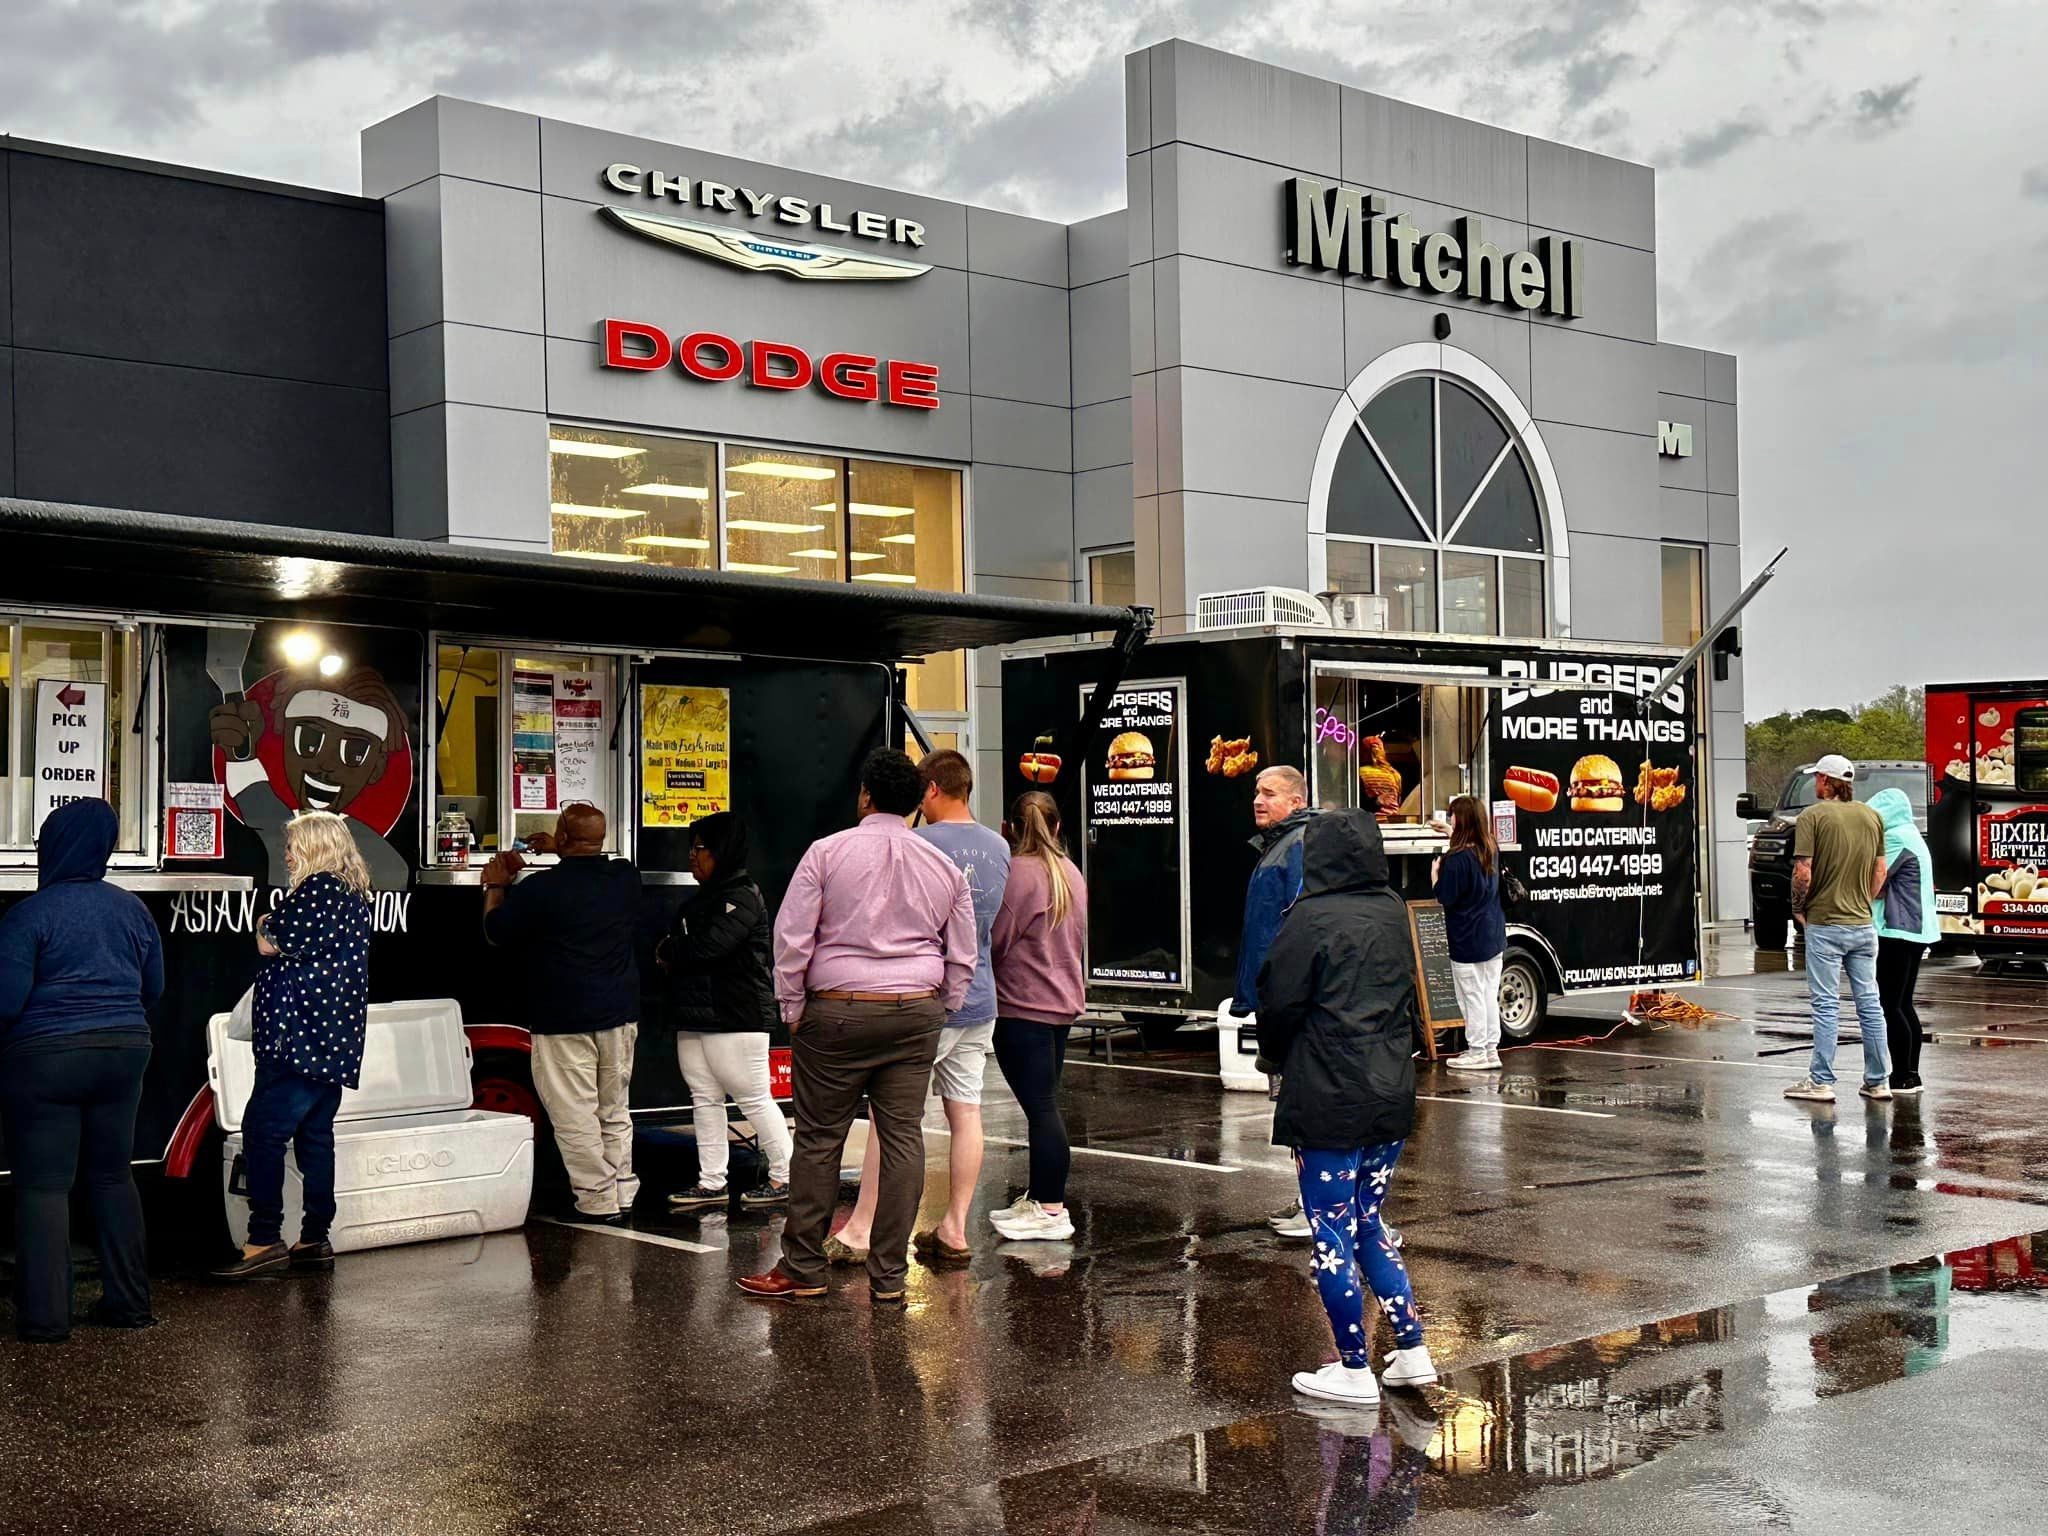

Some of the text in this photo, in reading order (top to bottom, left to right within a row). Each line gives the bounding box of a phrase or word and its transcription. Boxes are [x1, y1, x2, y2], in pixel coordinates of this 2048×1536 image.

[604, 163, 927, 248] CHRYSLER
[747, 244, 812, 260] CHRYSLER
[1287, 177, 1585, 319] Mitchell
[604, 318, 940, 410] DODGE
[1500, 659, 1686, 715] BURGERS
[330, 698, 350, 720] 福
[1107, 690, 1173, 713] RGERS
[1122, 705, 1138, 716] and
[1579, 693, 1613, 715] and
[52, 712, 87, 728] PICK
[1099, 714, 1173, 729] ORE THANGS
[1501, 716, 1686, 743] MORE THANGS
[58, 740, 80, 754] UP
[41, 767, 96, 782] ORDER
[1092, 782, 1173, 797] WE DO CATERING!
[50, 795, 92, 808] HE
[1094, 800, 1172, 815] (334) 447-1999
[1535, 826, 1656, 847] WE DO CATERING!
[1529, 853, 1663, 880] (334) 447-1999
[1530, 882, 1663, 904] martyssub@troycable.net
[170, 888, 258, 933] ASIAN
[1565, 968, 1600, 983] FOLLOW
[1601, 967, 1614, 981] US
[1614, 966, 1627, 980] ON
[1627, 964, 1657, 978] SOCIAL
[1657, 962, 1683, 977] MEDIA
[366, 1149, 457, 1177] IGLOO
